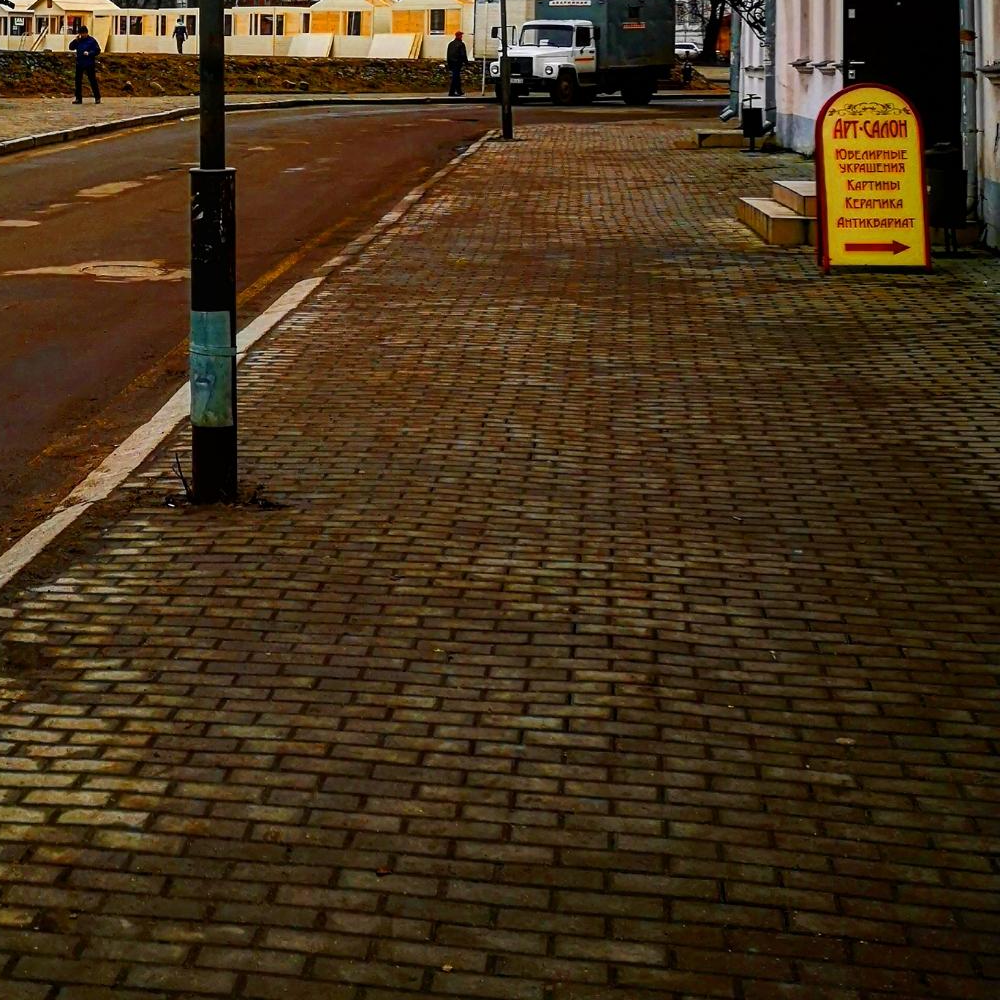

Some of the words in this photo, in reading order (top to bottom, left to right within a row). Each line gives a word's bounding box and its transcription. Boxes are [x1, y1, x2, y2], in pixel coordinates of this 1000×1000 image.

[835, 148, 908, 161] ЮВЕЛИРНЫЕ
[839, 162, 906, 174] УКРАШЕНИЯ
[847, 179, 901, 192] КАРТИНЫ
[845, 197, 904, 209] КЕРАМИКА
[837, 216, 915, 229] АНТИКВАРИАТ
